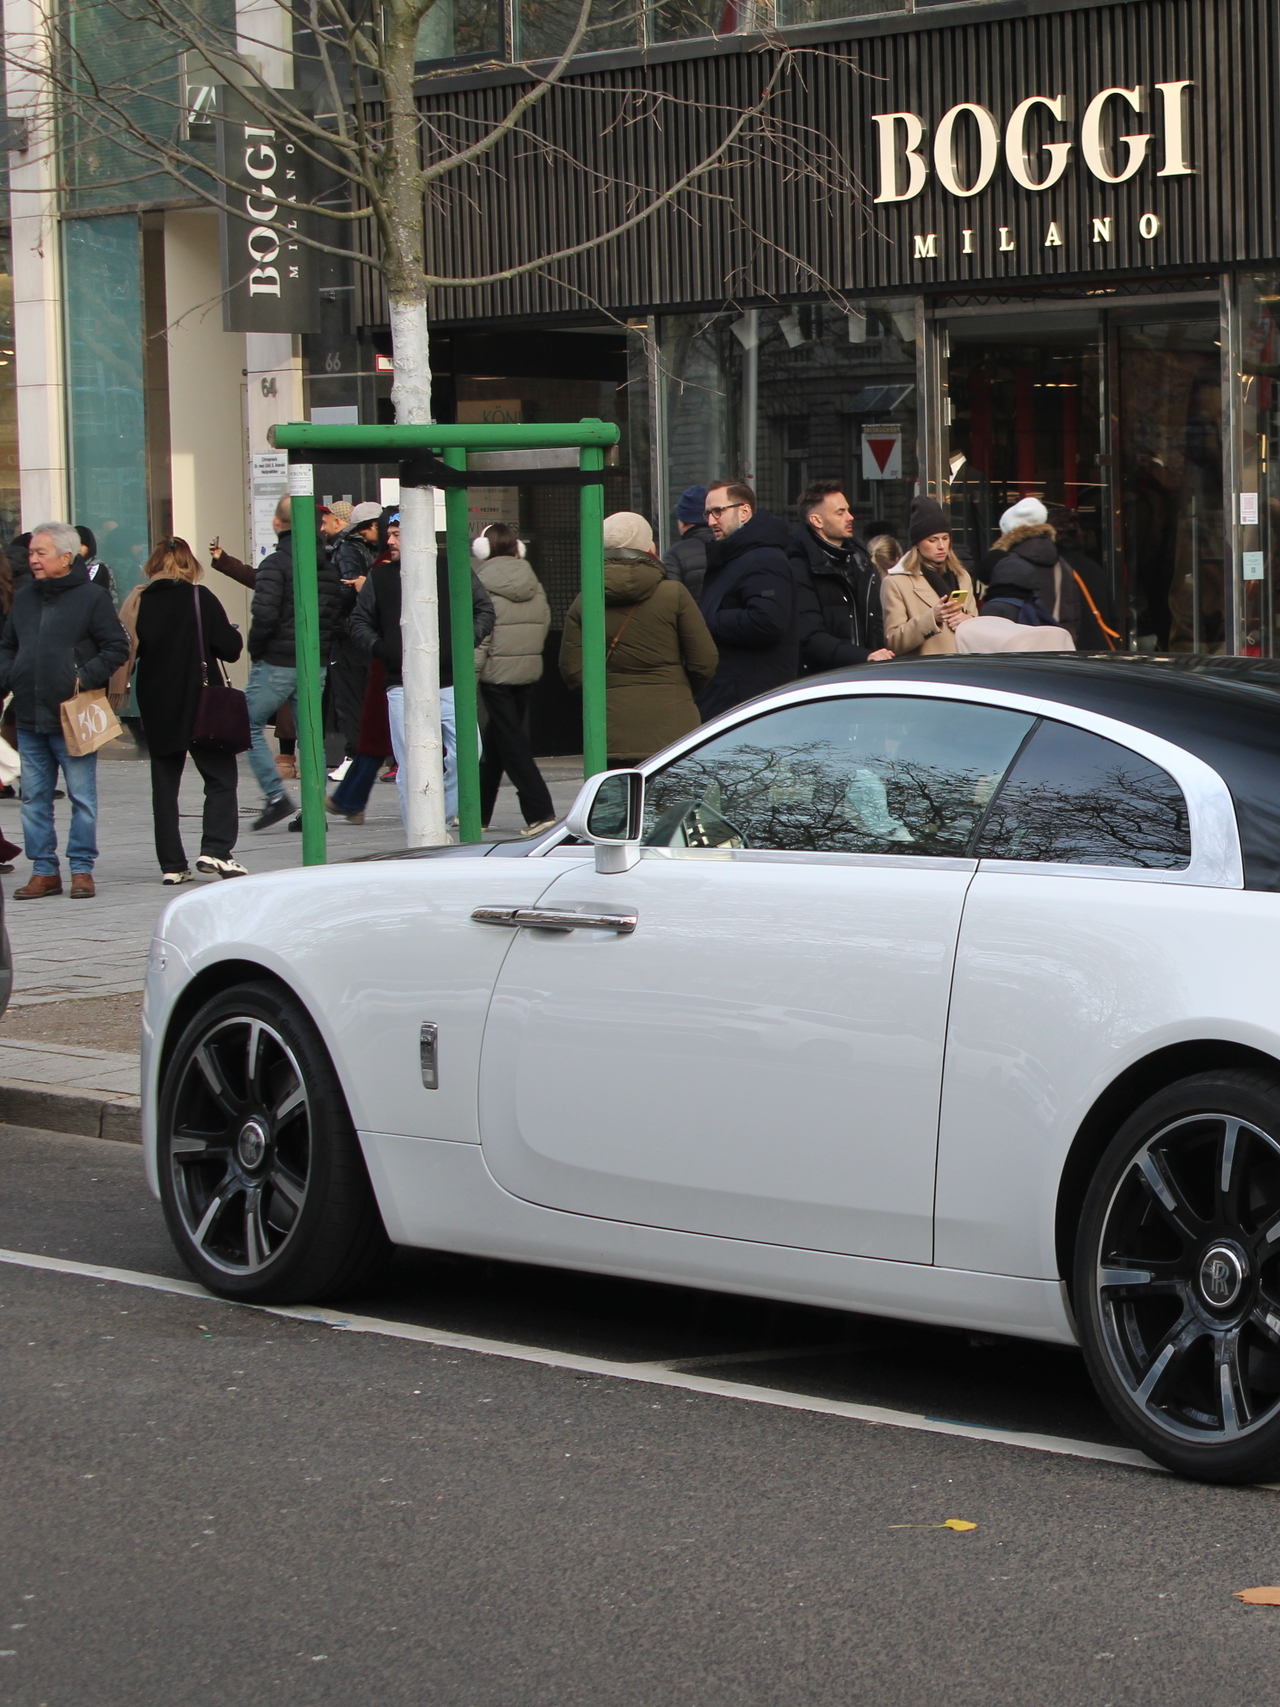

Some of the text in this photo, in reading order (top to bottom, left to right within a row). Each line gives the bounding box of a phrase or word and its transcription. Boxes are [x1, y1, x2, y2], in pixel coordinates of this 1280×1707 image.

[872, 80, 1198, 204] BOGGI
[244, 120, 281, 299] BOGGI
[285, 143, 299, 279] MILANO
[913, 212, 1161, 259] MILANO
[261, 377, 278, 398] 64
[325, 352, 341, 372] 66
